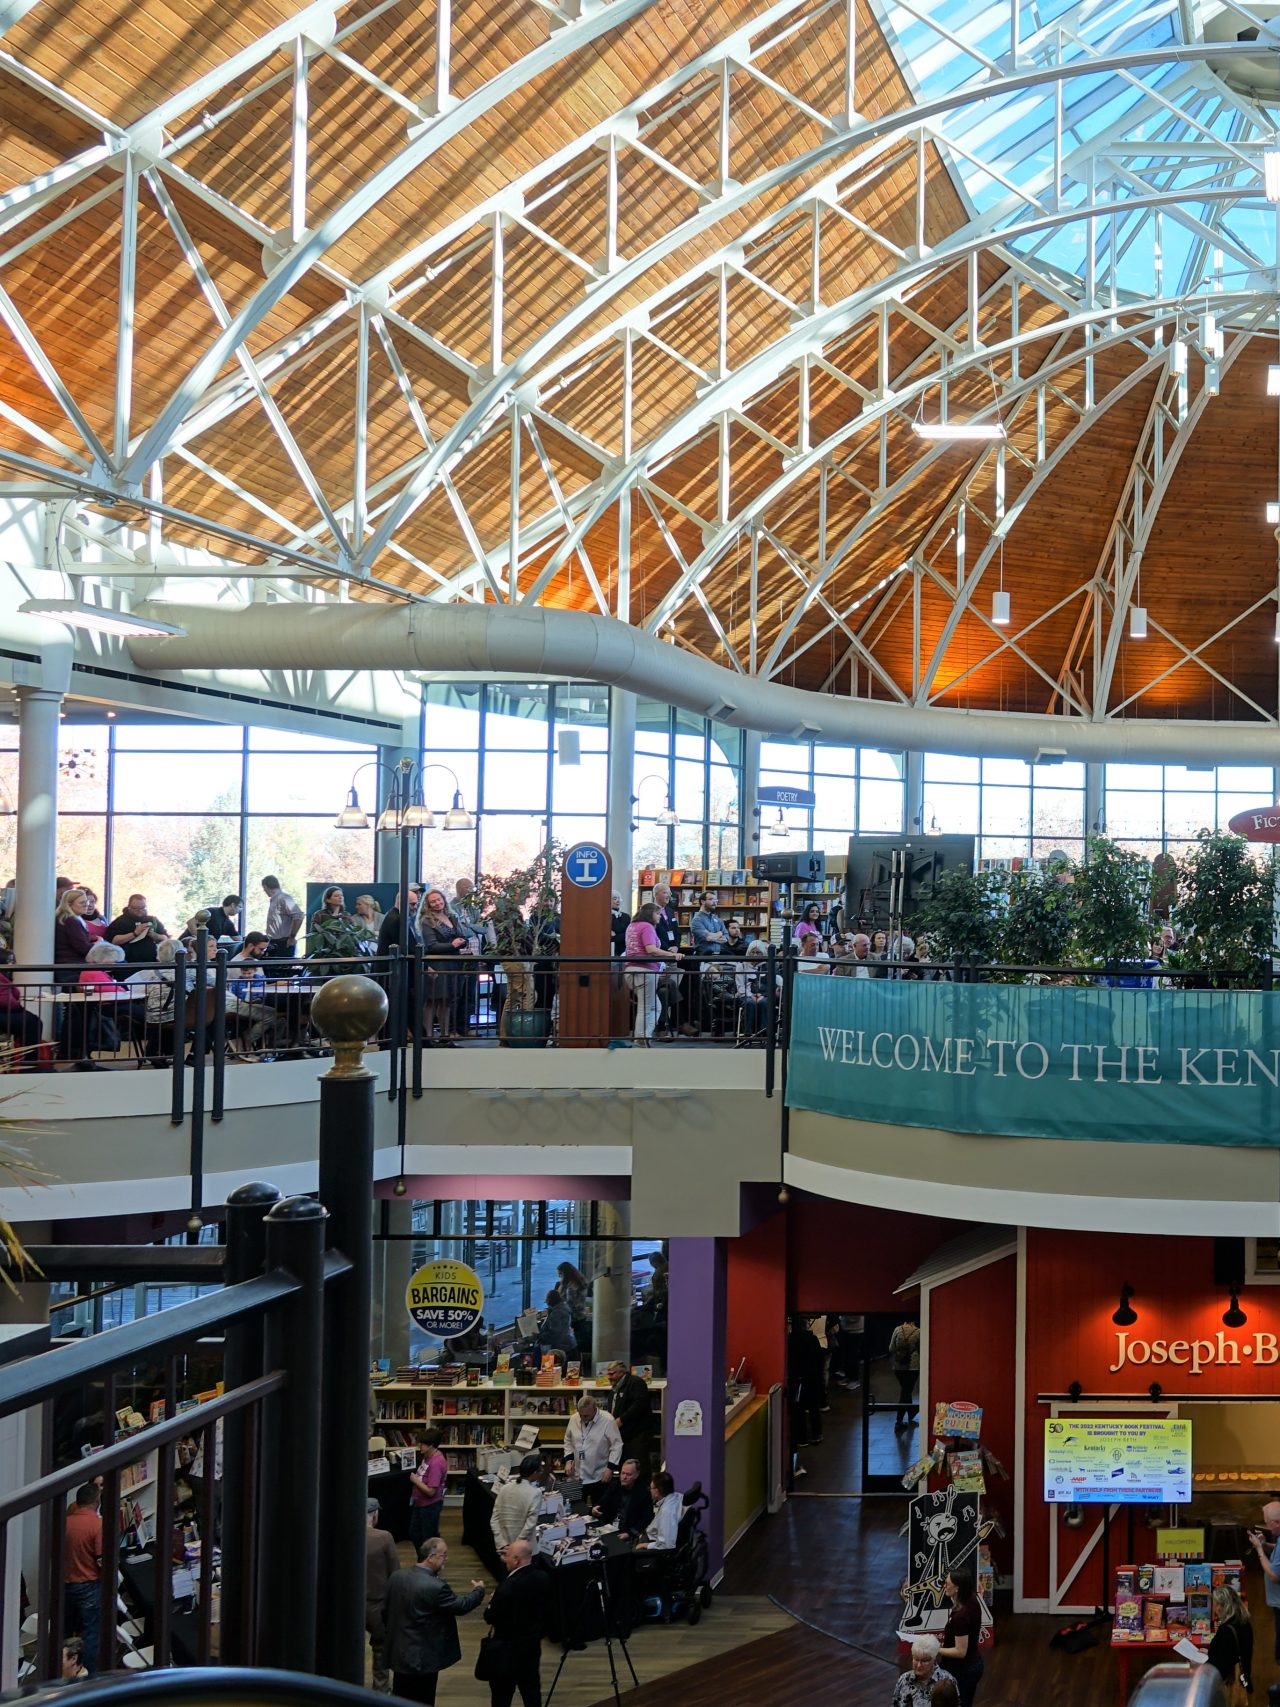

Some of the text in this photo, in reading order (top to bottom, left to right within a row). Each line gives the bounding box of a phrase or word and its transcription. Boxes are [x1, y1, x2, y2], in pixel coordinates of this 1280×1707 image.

[776, 791, 798, 802] POETRY
[576, 850, 598, 859] INFO
[817, 1026, 977, 1075] WELCOME
[986, 1039, 1049, 1079] TO
[1060, 1042, 1163, 1085] THE
[435, 1271, 457, 1280] KIDS
[411, 1286, 479, 1306] BARGAINS
[416, 1309, 474, 1321] SAVE 50%
[439, 1321, 463, 1329] MORE!
